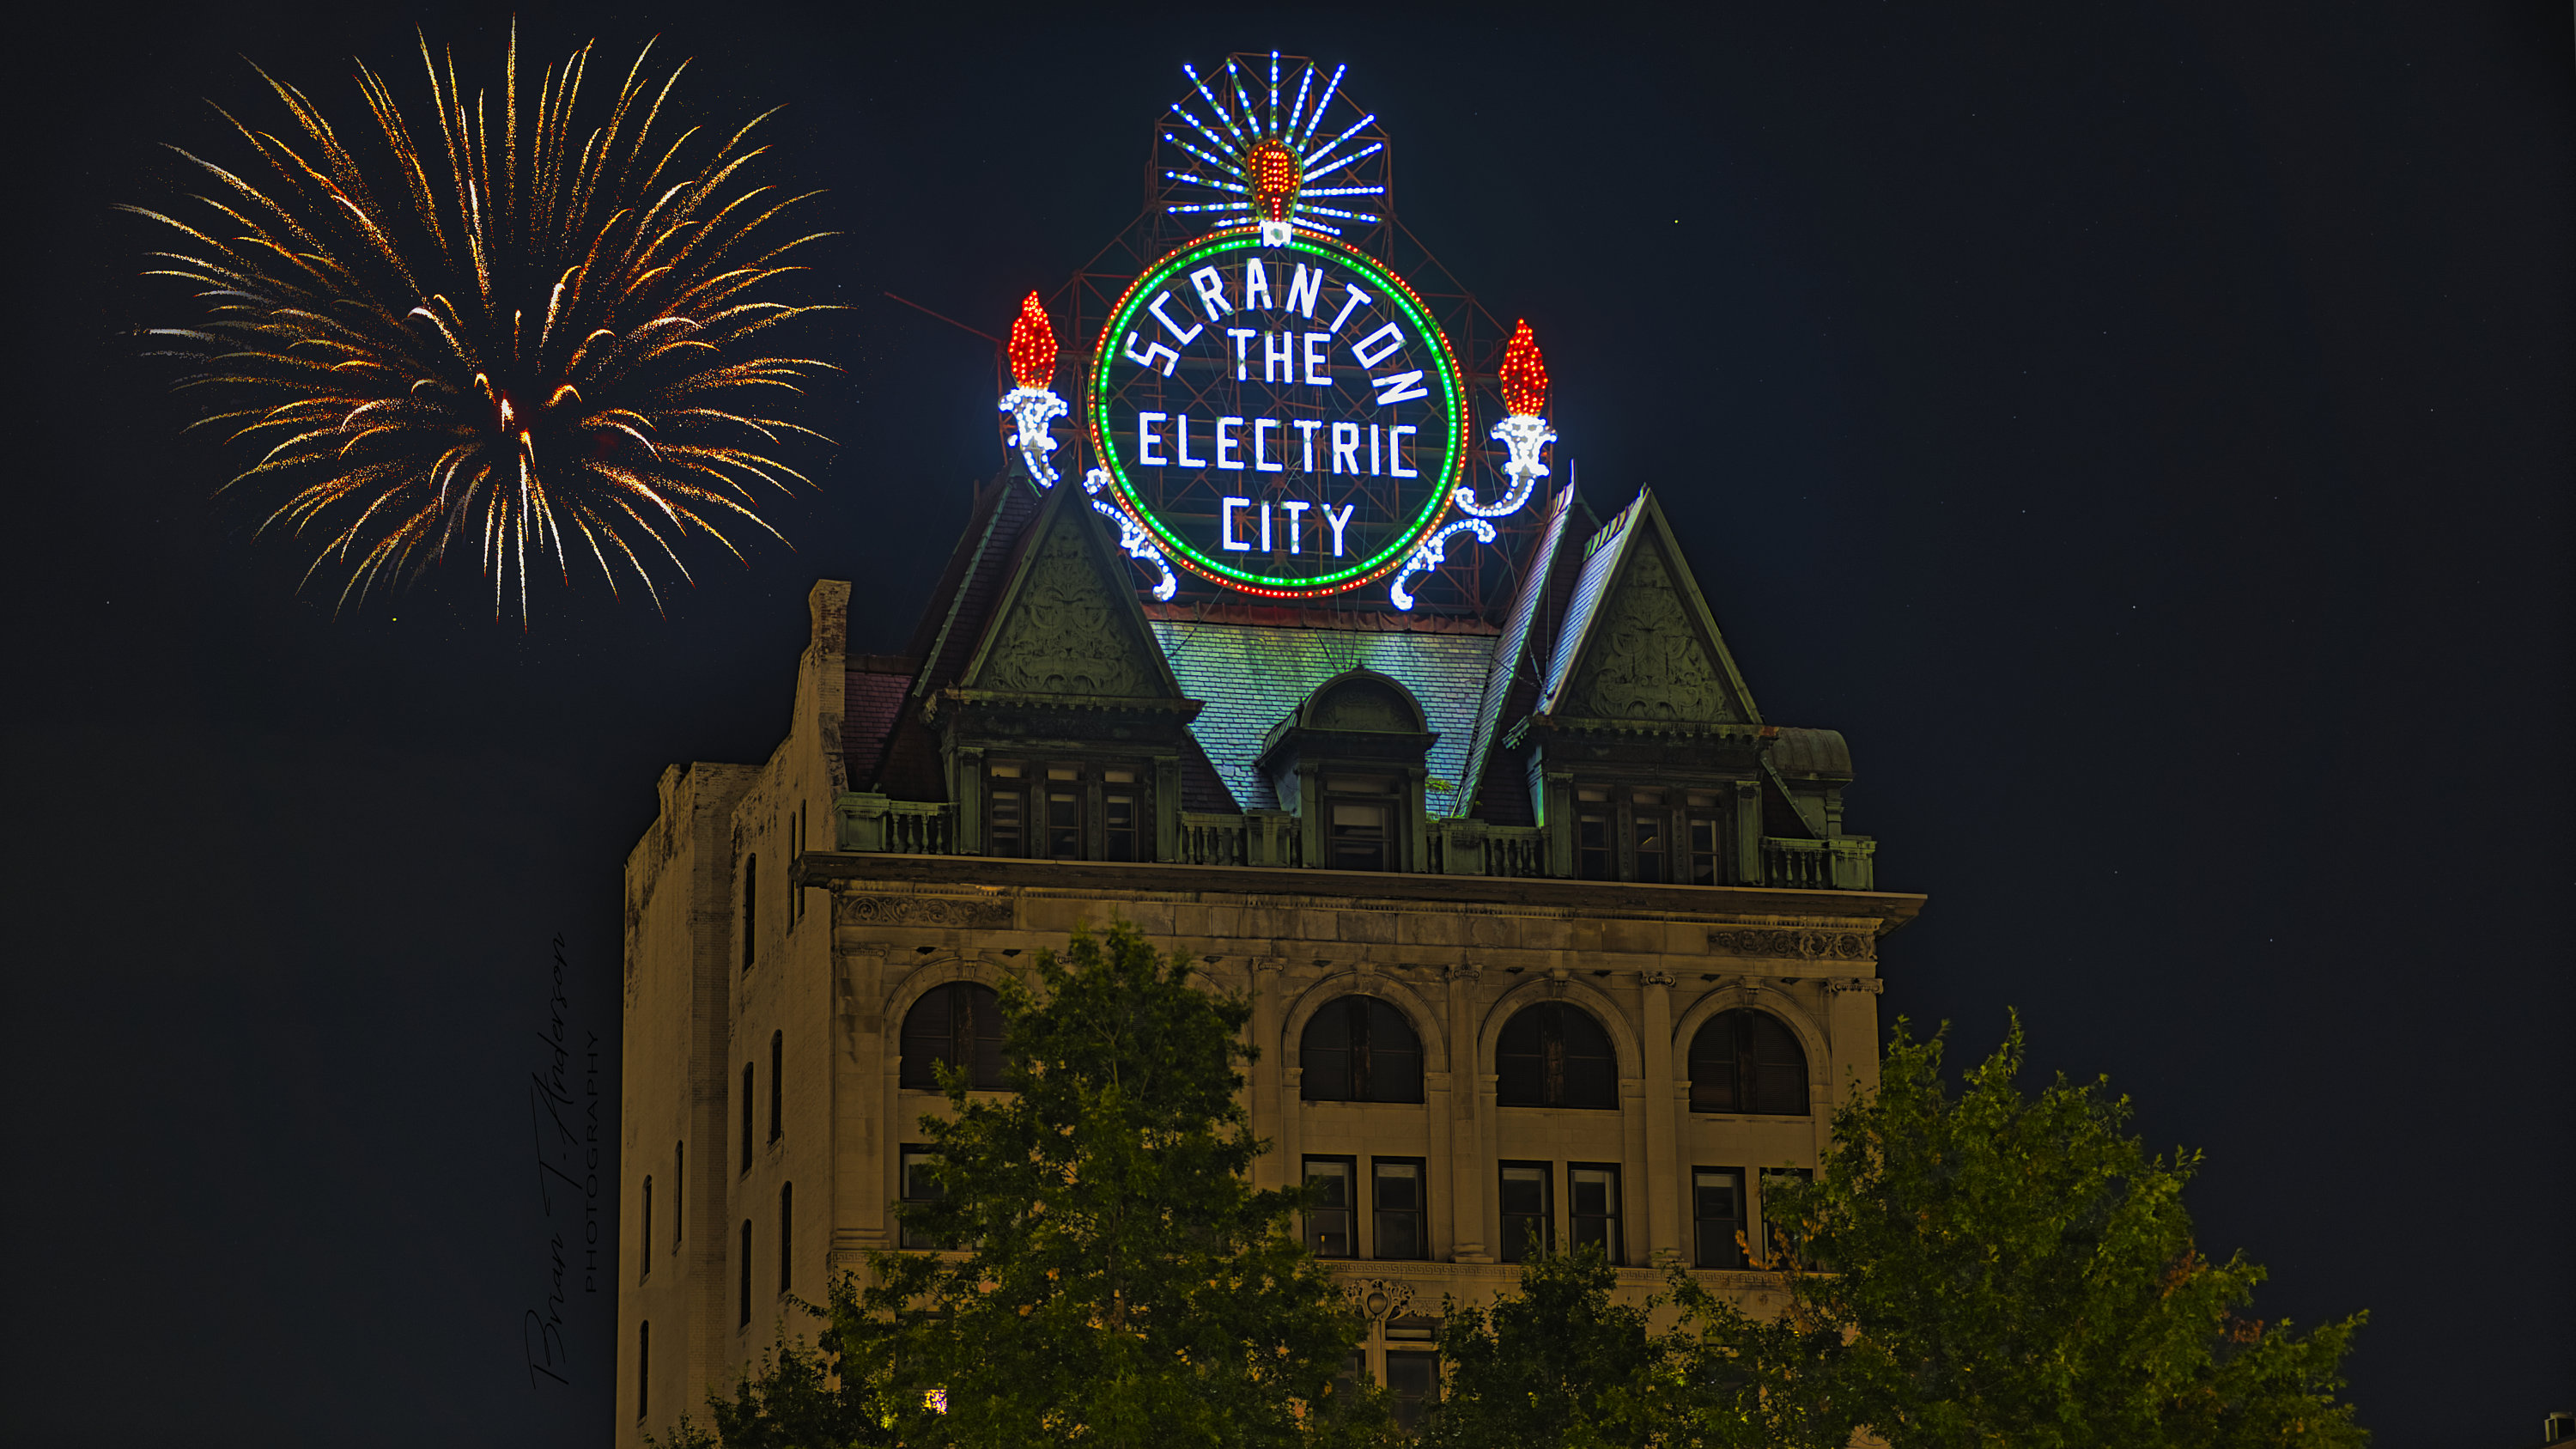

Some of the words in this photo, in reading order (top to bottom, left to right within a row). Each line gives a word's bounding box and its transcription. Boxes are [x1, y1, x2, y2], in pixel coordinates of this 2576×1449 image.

[1121, 258, 1428, 405] SCRANTON
[1227, 328, 1333, 386] THE
[1138, 411, 1418, 478] ELECTRIC
[1222, 496, 1354, 557] CITY
